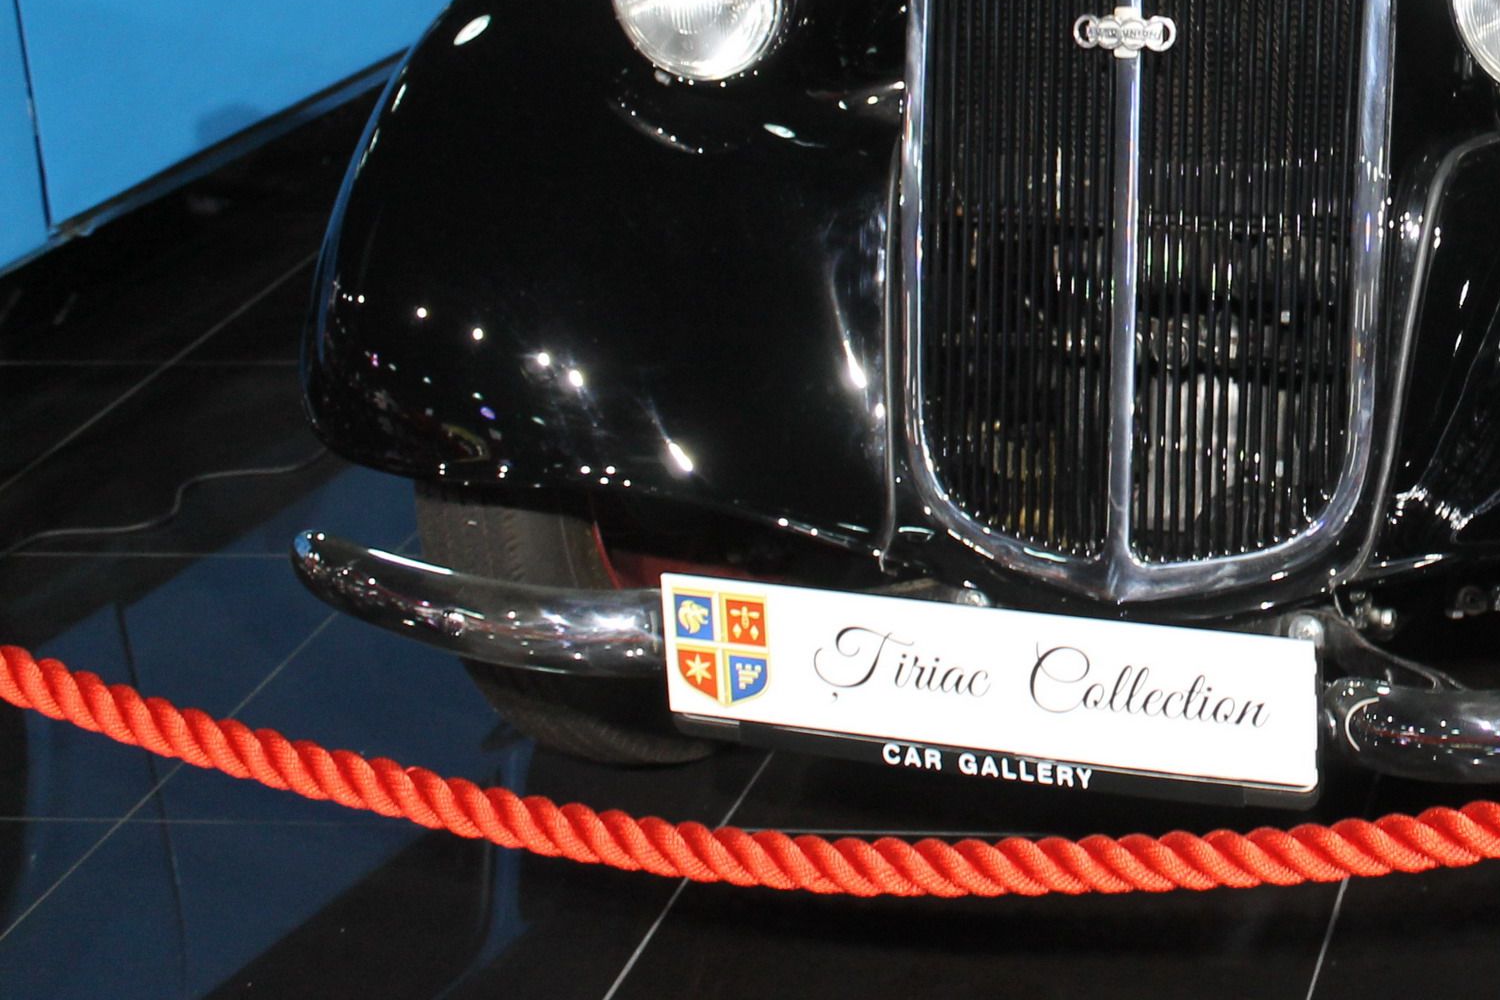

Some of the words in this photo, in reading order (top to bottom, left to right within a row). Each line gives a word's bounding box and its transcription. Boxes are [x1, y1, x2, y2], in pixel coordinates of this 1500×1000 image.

[1029, 642, 1269, 728] Collection
[882, 742, 942, 772] CAR
[958, 752, 1094, 790] GALLERY
